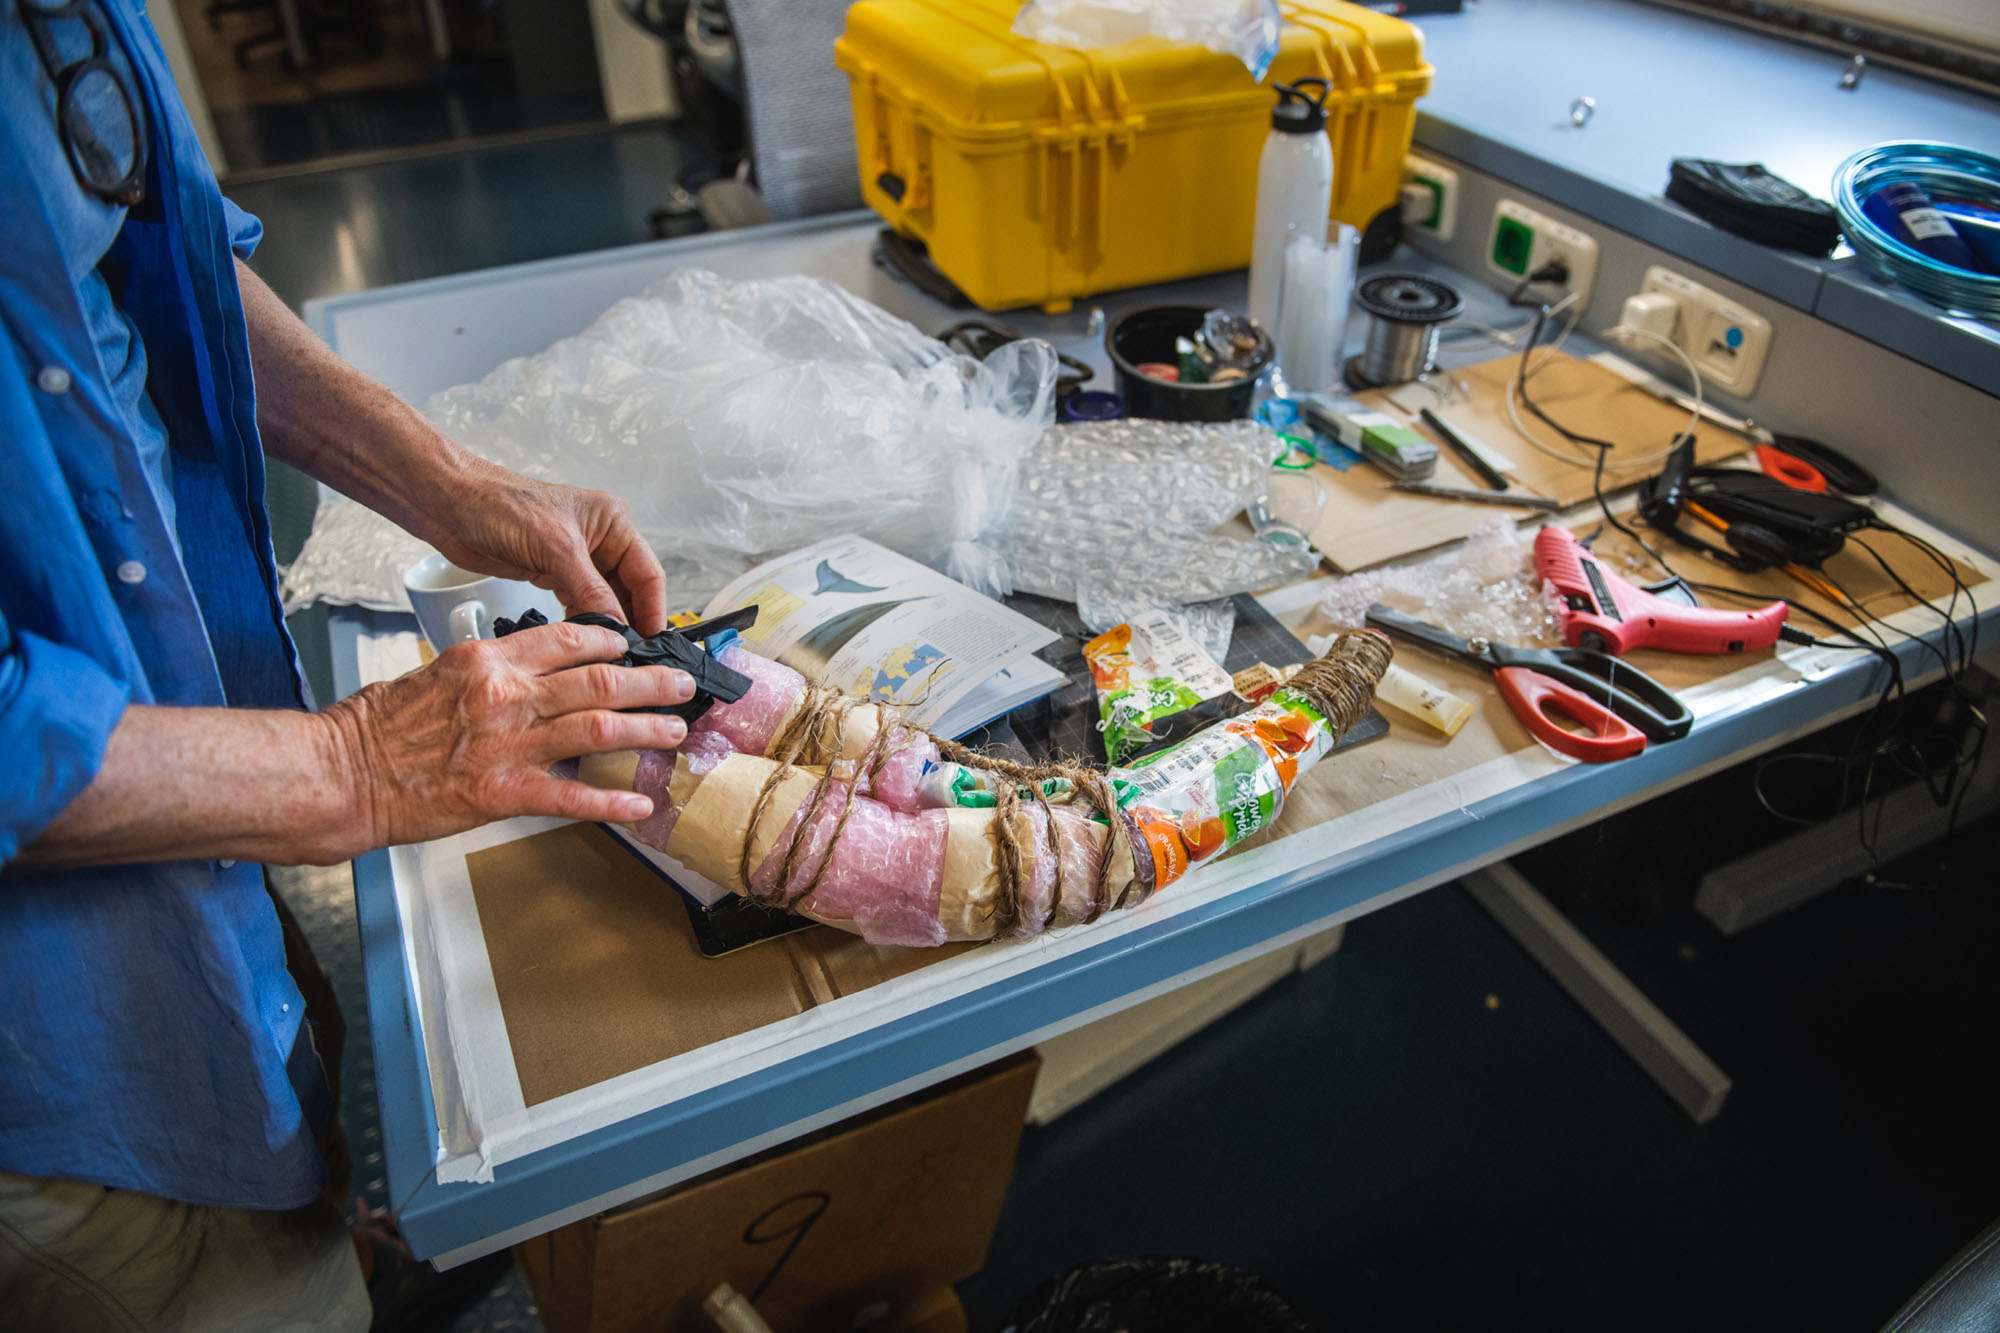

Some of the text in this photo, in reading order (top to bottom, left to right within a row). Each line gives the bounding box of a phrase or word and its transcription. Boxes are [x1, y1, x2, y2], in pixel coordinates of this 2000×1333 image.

[1228, 797, 1252, 840] Pride
[1159, 832, 1177, 864] ORANGE
[743, 1191, 831, 1305] 9
